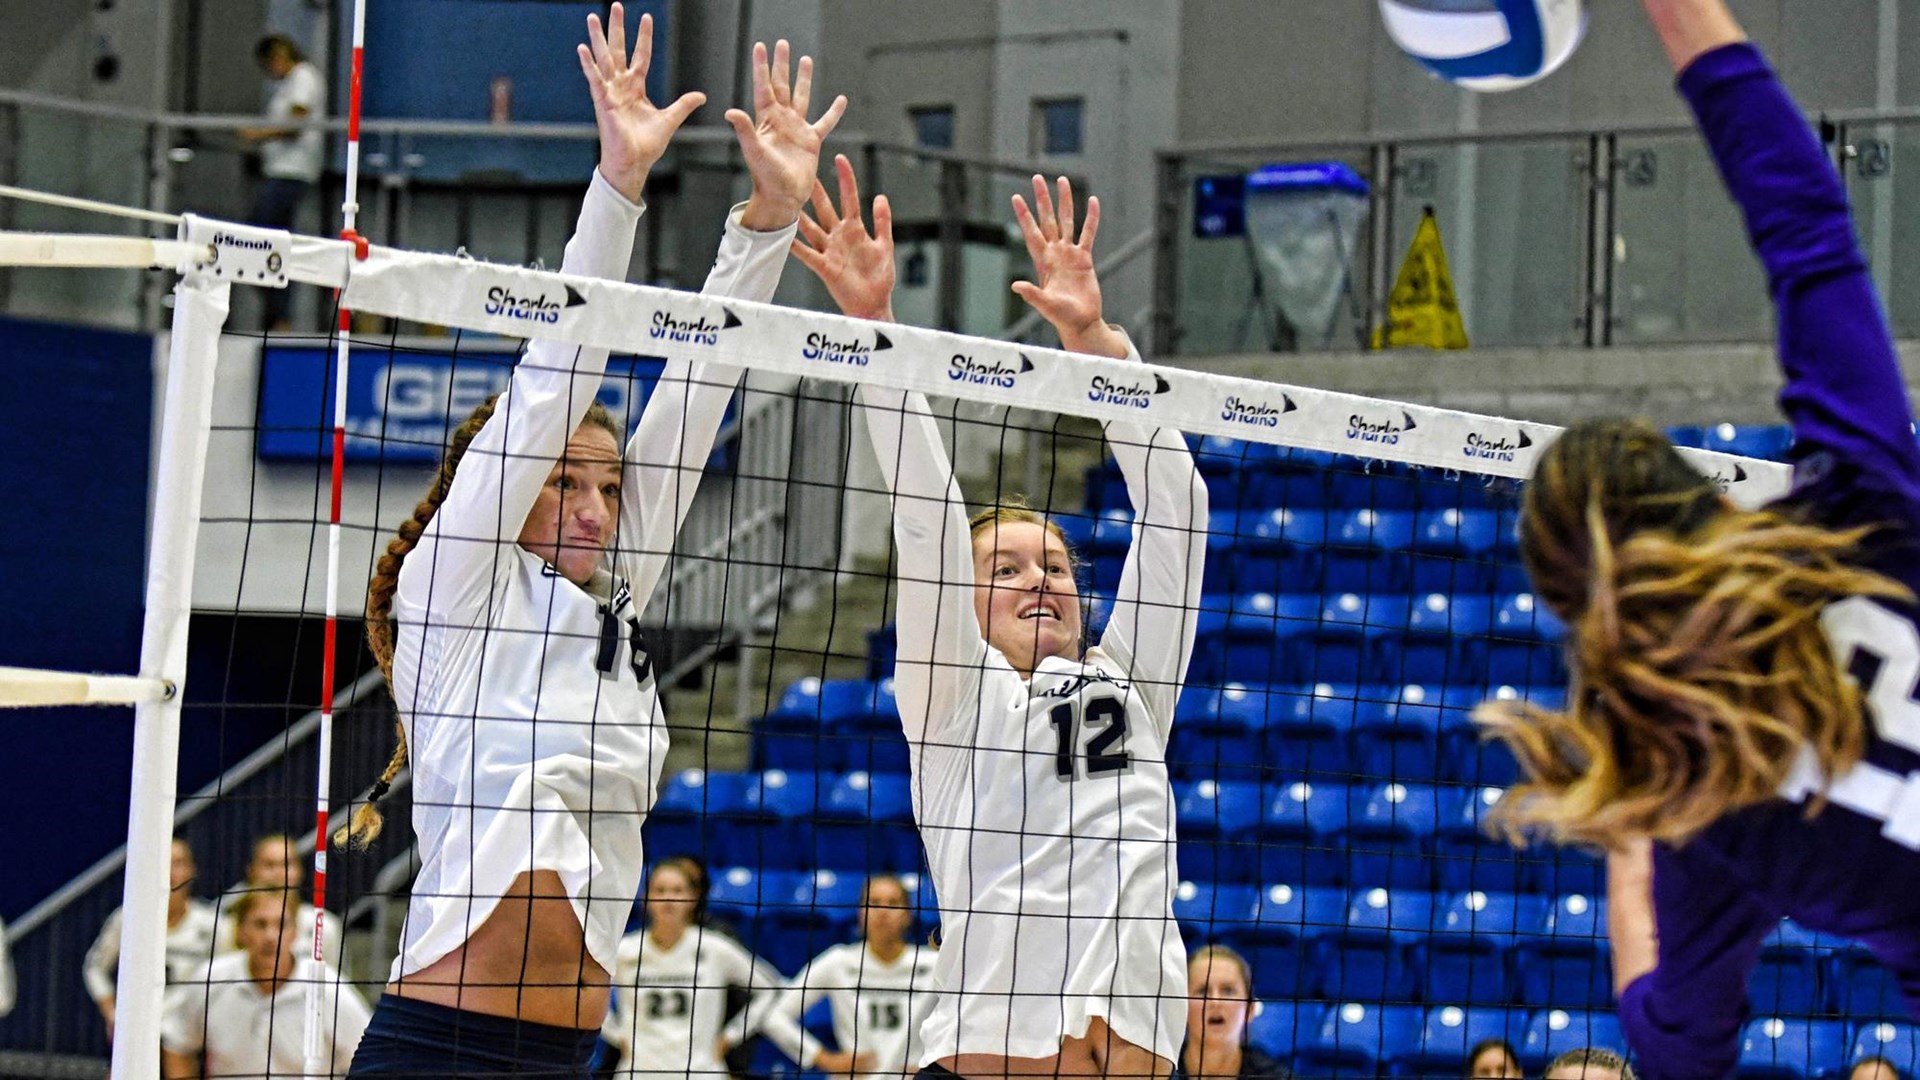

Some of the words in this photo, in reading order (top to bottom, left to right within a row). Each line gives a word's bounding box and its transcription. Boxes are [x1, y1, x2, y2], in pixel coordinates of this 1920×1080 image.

[225, 235, 272, 251] Senoh
[484, 285, 561, 324] Sharks
[649, 310, 719, 346] Sharks
[802, 332, 870, 366] Sharks
[948, 353, 1017, 388] Sharks
[1088, 375, 1151, 409] Sharks
[1221, 396, 1279, 427] Sharks
[1346, 414, 1400, 445] Sharks
[1463, 432, 1516, 462] Sharks
[1048, 695, 1135, 783] 12
[645, 990, 689, 1019] 23
[867, 1002, 902, 1031] 15
